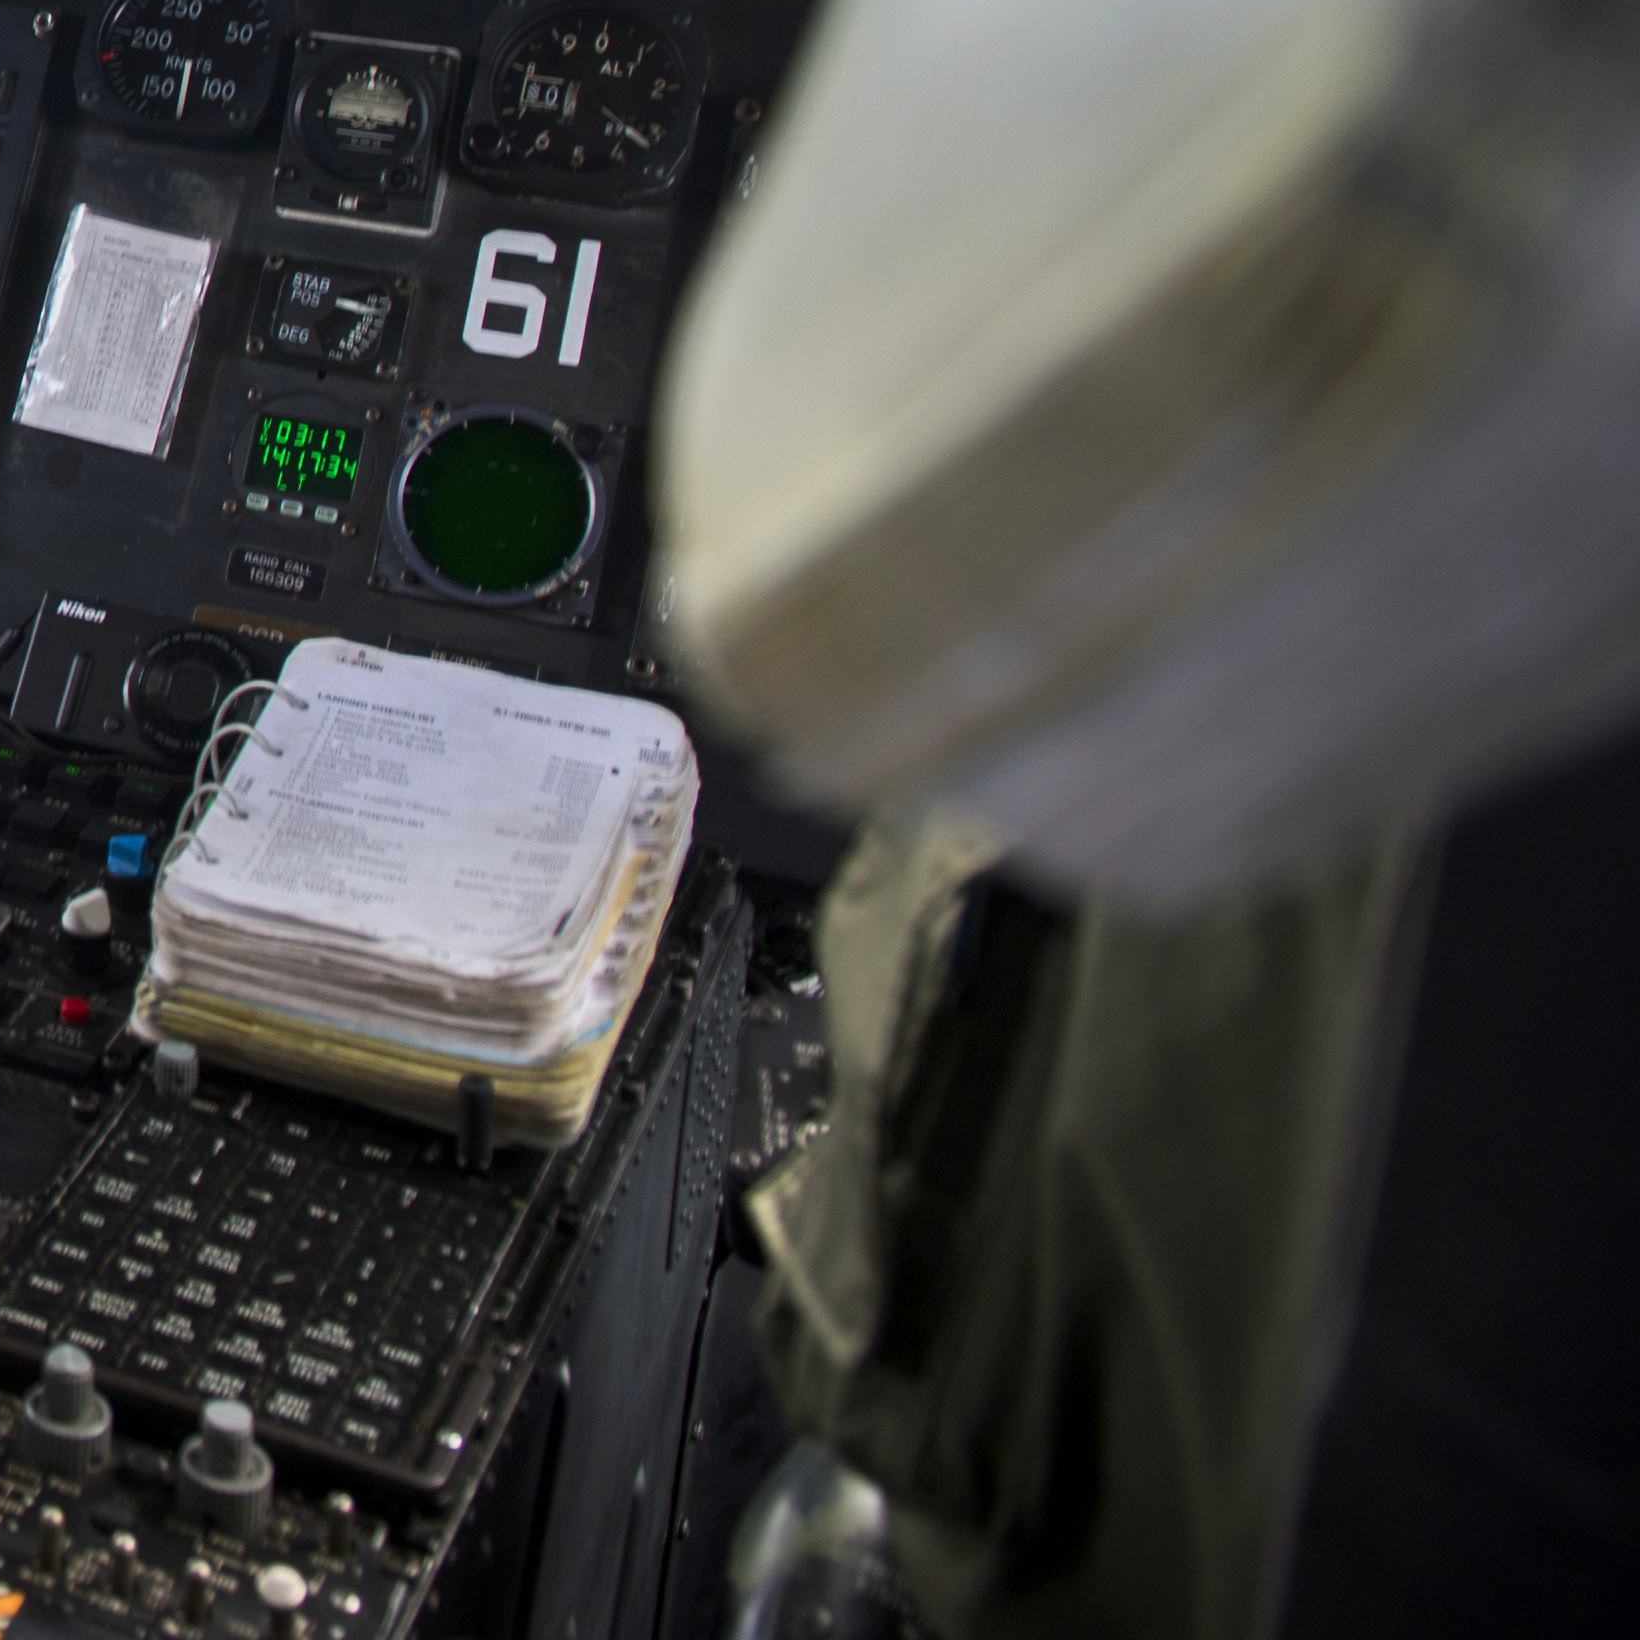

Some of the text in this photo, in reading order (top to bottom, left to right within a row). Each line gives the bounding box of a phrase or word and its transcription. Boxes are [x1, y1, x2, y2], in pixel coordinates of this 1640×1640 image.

[130, 26, 173, 52] 200
[224, 20, 254, 46] 50
[562, 32, 610, 55] 9 0
[164, 54, 213, 75] KNTS
[599, 59, 637, 78] ALT
[140, 73, 236, 103] 150 100
[650, 78, 666, 100] 2
[292, 271, 331, 295] STAB
[290, 286, 321, 308] POS
[463, 229, 602, 366] 61
[278, 322, 310, 344] DEG
[275, 419, 346, 453] 03:17
[263, 443, 358, 481] 14:17:34
[243, 550, 313, 577] RADIO CALL
[56, 599, 108, 624] Nikon
